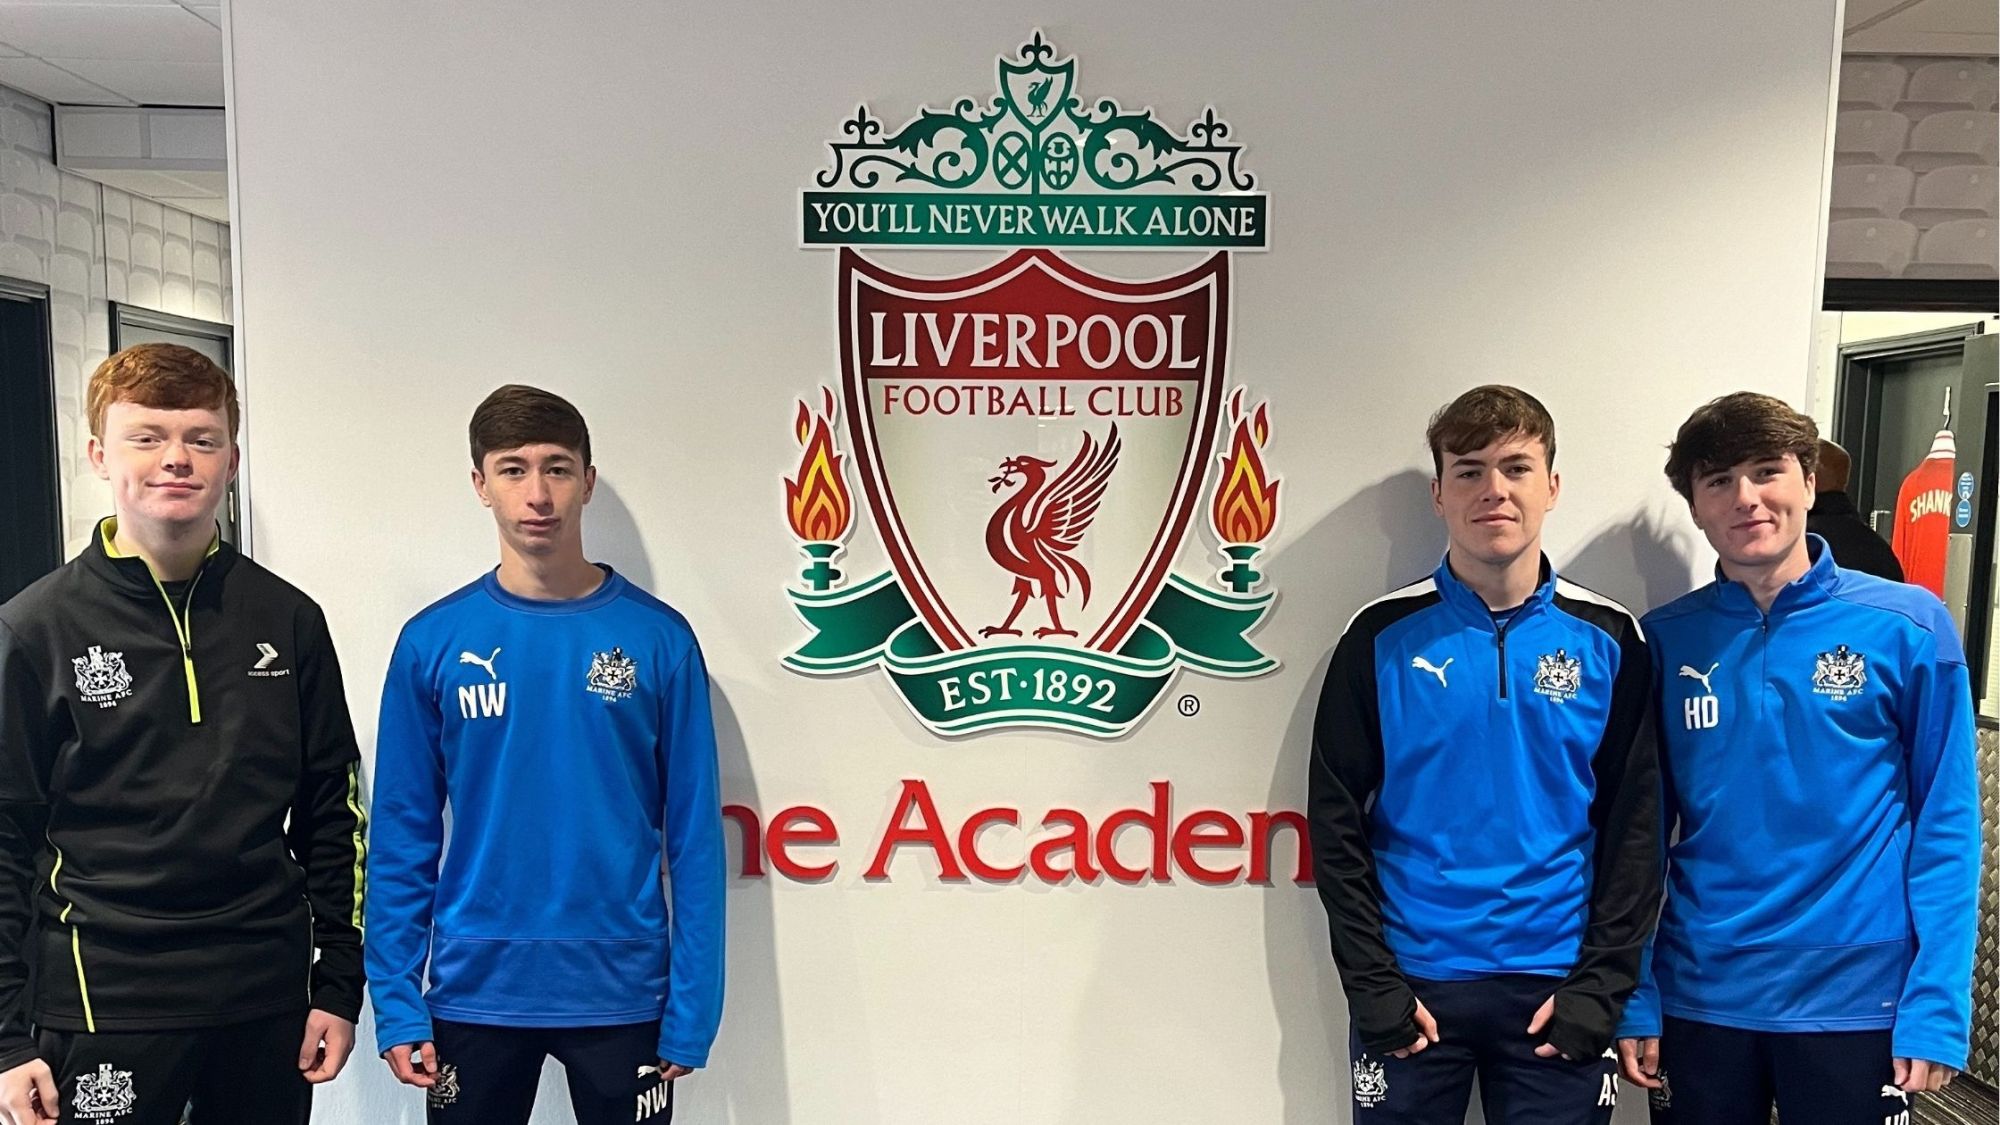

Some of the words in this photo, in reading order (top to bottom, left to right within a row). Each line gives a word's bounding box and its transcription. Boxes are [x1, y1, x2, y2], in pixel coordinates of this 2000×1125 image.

[811, 202, 921, 234] YOU'LL
[928, 203, 1037, 236] NEVER
[1036, 205, 1138, 236] WALK
[1142, 206, 1256, 237] ALONE
[869, 312, 1200, 370] LIVERPOOL
[883, 384, 1076, 416] FOOTBALL
[1087, 386, 1184, 417] CLUB
[1910, 488, 1953, 523] SHANK
[80, 694, 113, 702] MARINE
[115, 689, 133, 700] AFC
[458, 682, 507, 720] NW
[586, 685, 617, 697] MARINE
[1812, 687, 1845, 695] MARINE
[1684, 695, 1719, 730] HD
[863, 779, 1315, 885] Academ
[74, 1111, 112, 1119] MARINE
[114, 1107, 133, 1117] AFC
[635, 1080, 668, 1122] NW
